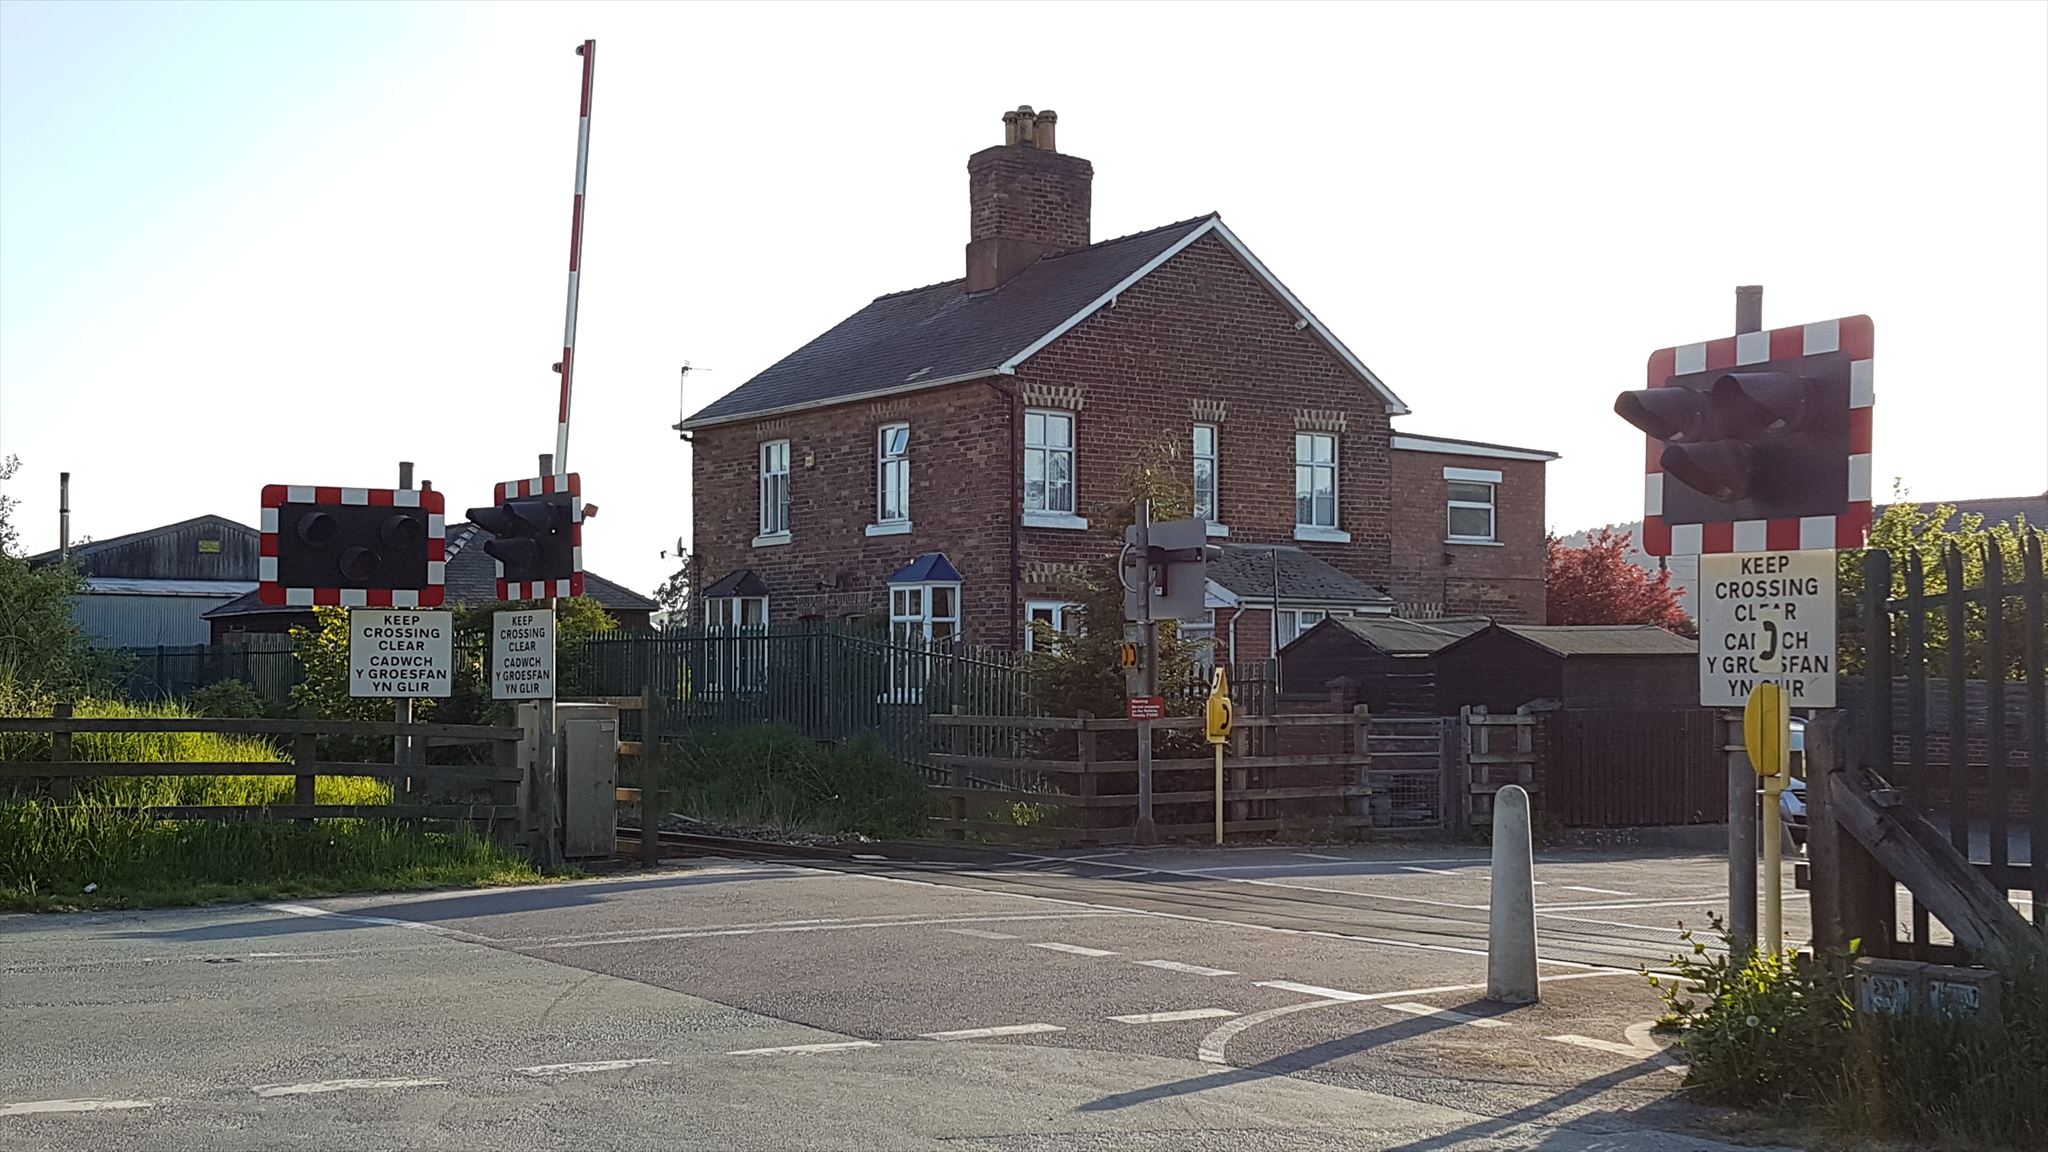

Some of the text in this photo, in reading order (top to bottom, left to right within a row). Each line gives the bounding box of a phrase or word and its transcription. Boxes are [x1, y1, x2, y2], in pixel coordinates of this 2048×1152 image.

[1741, 555, 1790, 576] KEEP
[1715, 577, 1818, 600] CROSSING
[1735, 602, 1797, 622] CLR
[384, 615, 420, 626] KEEP
[511, 615, 533, 626] KEEP
[363, 627, 440, 639] CROSSING
[500, 627, 546, 640] CROSSING
[378, 640, 425, 651] CLEAR
[508, 640, 536, 652] CLEAR
[1724, 631, 1809, 651] CACH
[369, 656, 433, 667] CADWCH
[503, 656, 541, 668] CADWCH
[1707, 656, 1718, 674] Y
[355, 669, 447, 680] Y GROESFAN
[495, 669, 550, 682] Y GROESFAN
[372, 682, 430, 692] YN GLIR
[505, 683, 540, 694] YN GLIR
[1727, 679, 1753, 697] YN
